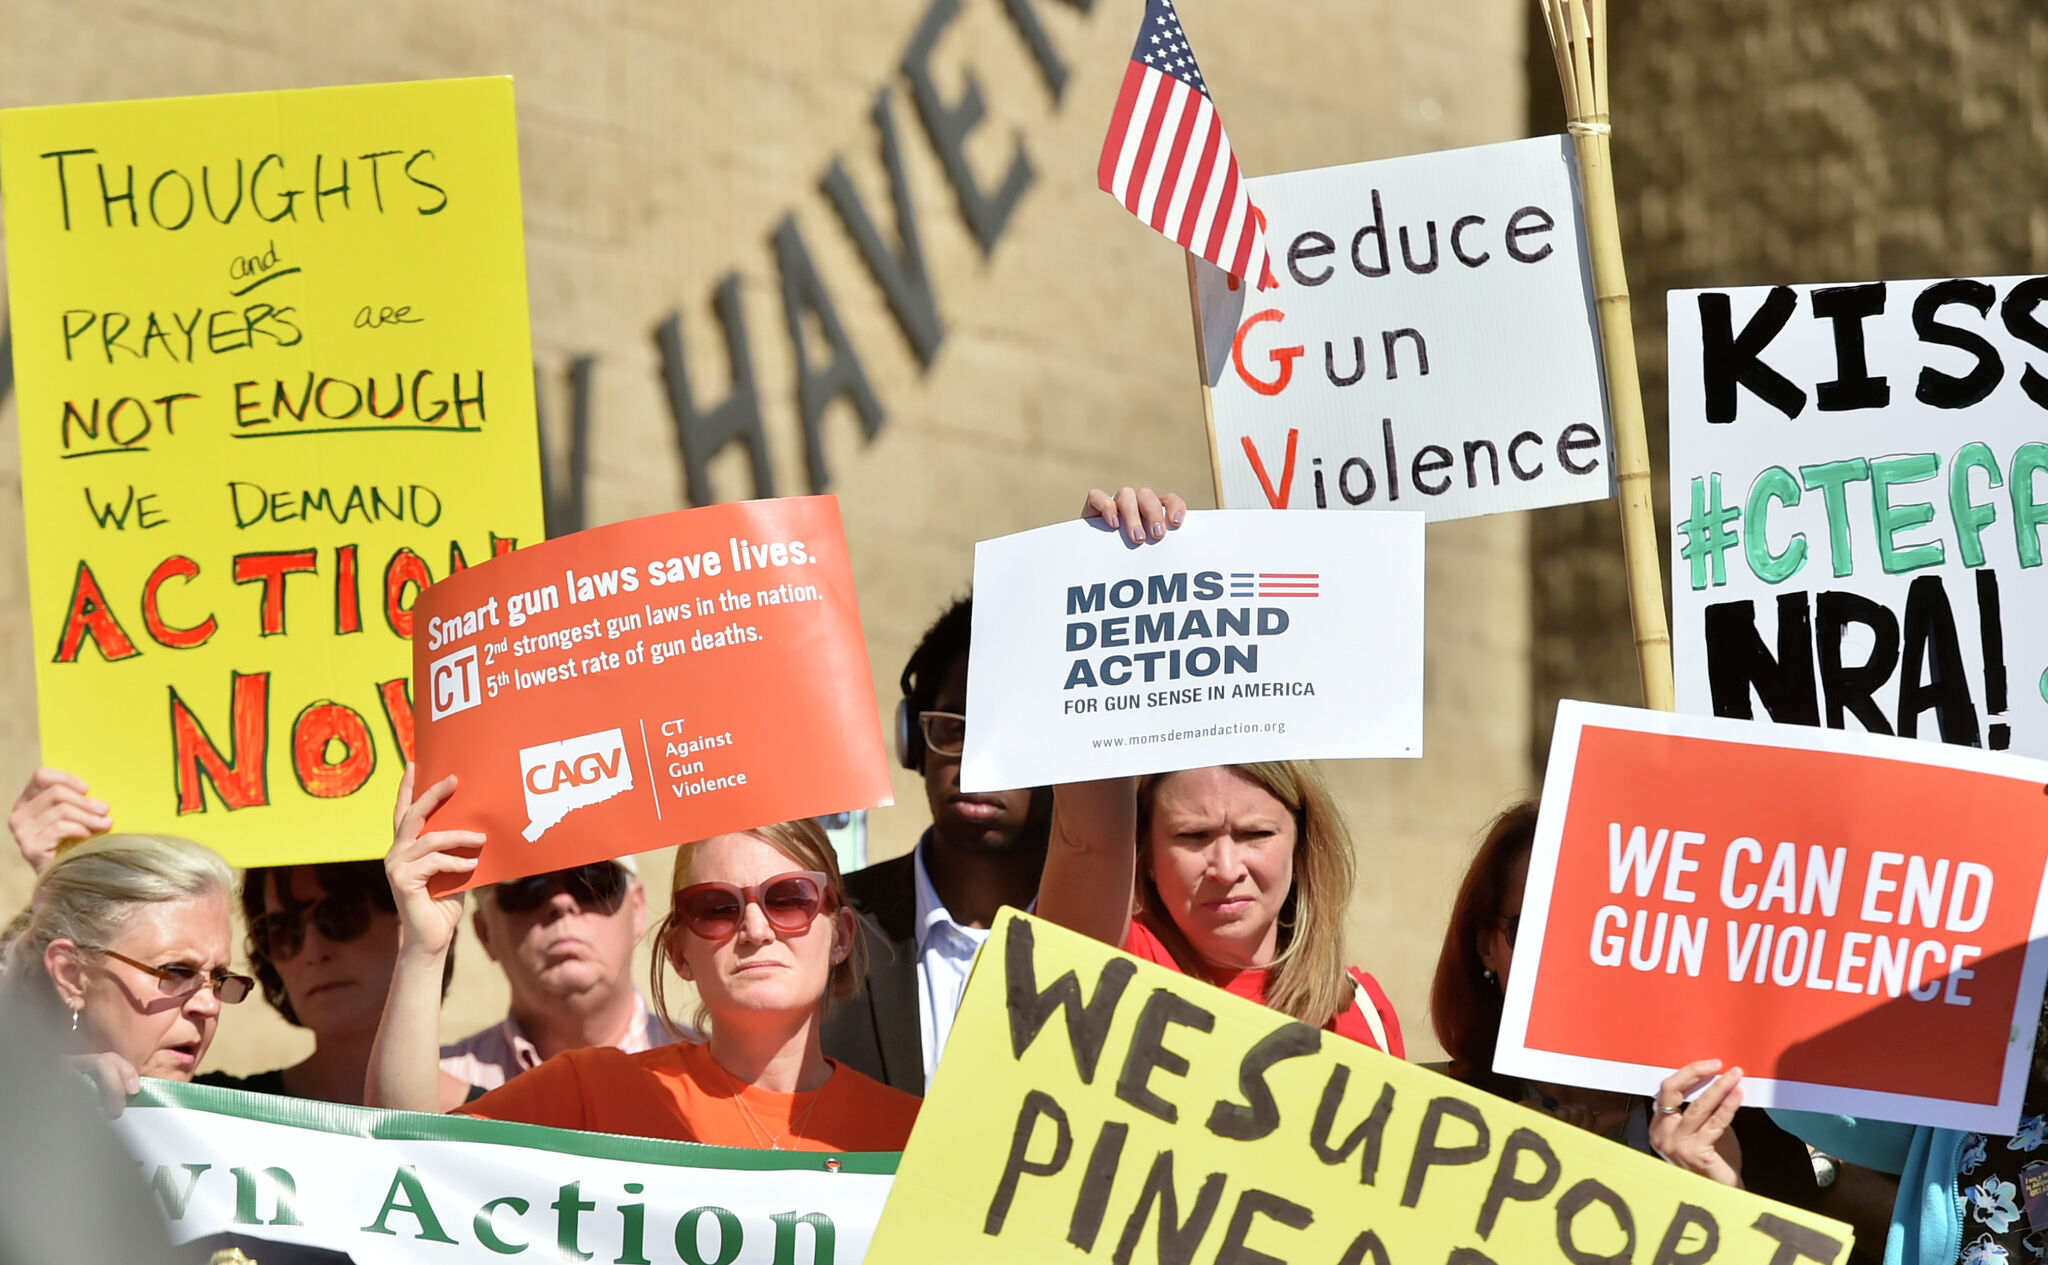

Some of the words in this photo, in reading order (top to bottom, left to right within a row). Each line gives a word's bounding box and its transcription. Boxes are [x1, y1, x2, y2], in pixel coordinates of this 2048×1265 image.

[40, 148, 448, 231] THOUGHTS
[230, 240, 280, 280] and
[1228, 189, 1555, 290] educe
[62, 304, 302, 363] PRAYERS
[1232, 308, 1430, 396] Gun
[61, 394, 202, 449] NOT
[234, 370, 486, 429] ENOUGH
[1240, 418, 1602, 509] Violence
[84, 485, 170, 530] WE
[226, 481, 441, 528] DEMAND
[428, 596, 499, 651] Smart
[507, 581, 560, 628] gun
[566, 564, 640, 606] laws
[648, 549, 722, 587] save
[729, 537, 817, 573] lives.
[1065, 571, 1225, 615] MOMS
[484, 639, 508, 665] 2nd
[513, 618, 602, 657] strongest
[606, 612, 641, 641] gun
[646, 600, 692, 628] laws
[696, 598, 715, 617] in
[719, 590, 753, 613] the
[756, 583, 823, 607] nation.
[1065, 607, 1290, 652] DEMAND
[434, 654, 475, 713] CT
[486, 671, 510, 698] 5th
[515, 660, 578, 691] lowest
[582, 649, 620, 677] rate
[625, 643, 645, 666] of
[650, 642, 686, 666] gun
[690, 624, 764, 652] deaths.
[1063, 644, 1259, 690] ACTION
[1704, 568, 2011, 751] NRA!
[1064, 697, 1098, 715] FOR
[1104, 693, 1141, 712] GUN
[1147, 688, 1203, 708] SENSE
[1208, 686, 1226, 702] IN
[1231, 681, 1316, 699] AMERICA
[660, 719, 686, 737] CT
[664, 731, 733, 758] Against
[1091, 720, 1286, 749] www.momsdemandaction.org
[525, 747, 622, 795] CAGV
[668, 759, 704, 779] Gun
[671, 773, 747, 799] Violence
[1608, 821, 1706, 903] WE
[1718, 836, 1848, 917] CAN
[1859, 850, 1994, 933] END
[1589, 904, 1709, 978] GUN
[1726, 920, 1983, 1007] VIOLENCE
[1004, 916, 1215, 1124] WE
[360, 1162, 838, 1265] Action
